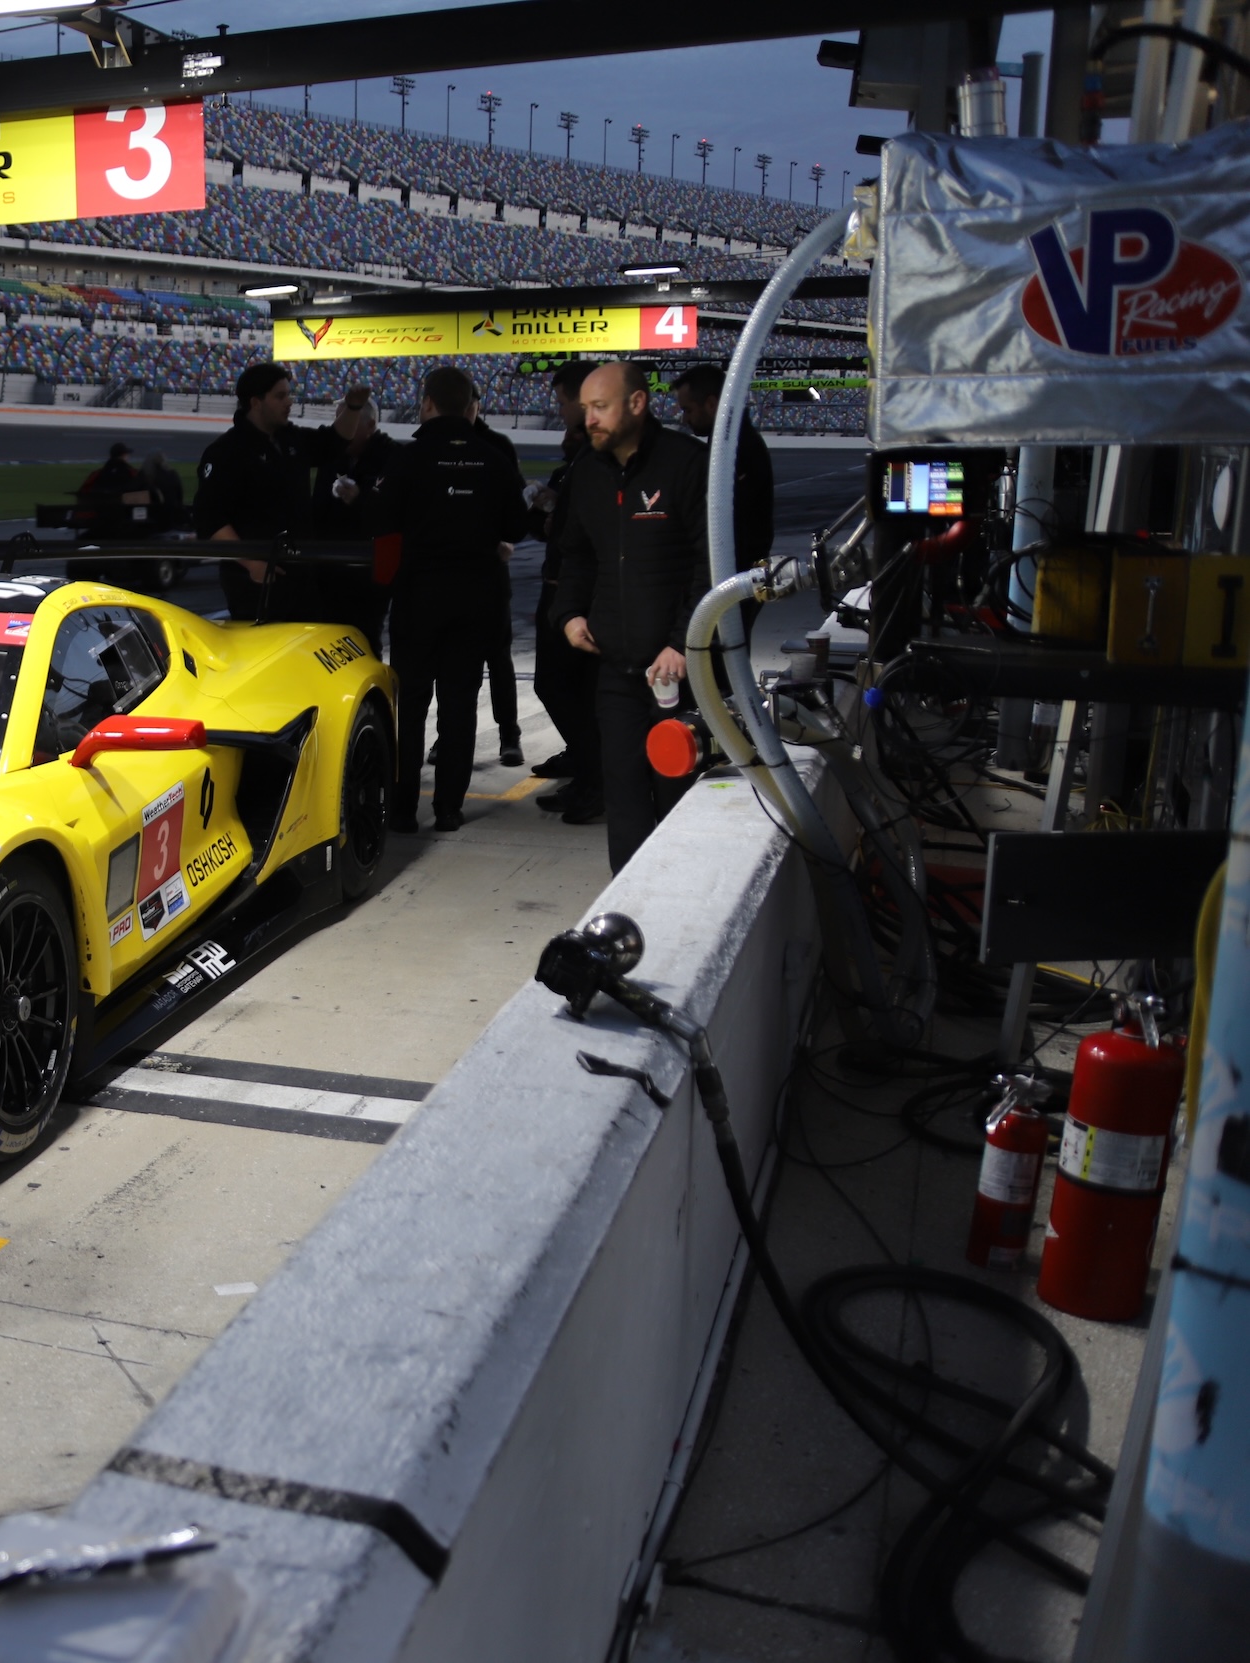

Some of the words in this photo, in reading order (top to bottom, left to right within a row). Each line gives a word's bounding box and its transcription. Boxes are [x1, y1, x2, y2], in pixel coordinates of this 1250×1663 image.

[105, 100, 172, 201] 3
[1028, 208, 1176, 355] VP
[655, 306, 688, 344] 4
[1123, 280, 1239, 337] Racing
[326, 334, 443, 346] RACING
[338, 326, 435, 336] CORVETTE
[512, 320, 609, 335] MILLER
[512, 337, 610, 346] MOTORSPORTS
[1122, 337, 1198, 352] FUELS
[313, 638, 359, 674] Mobil
[143, 785, 183, 821] WeatherTech
[153, 819, 170, 880] 3
[186, 832, 238, 887] OSHKOSH
[113, 915, 131, 941] PRO
[180, 974, 205, 994] GATEWAY
